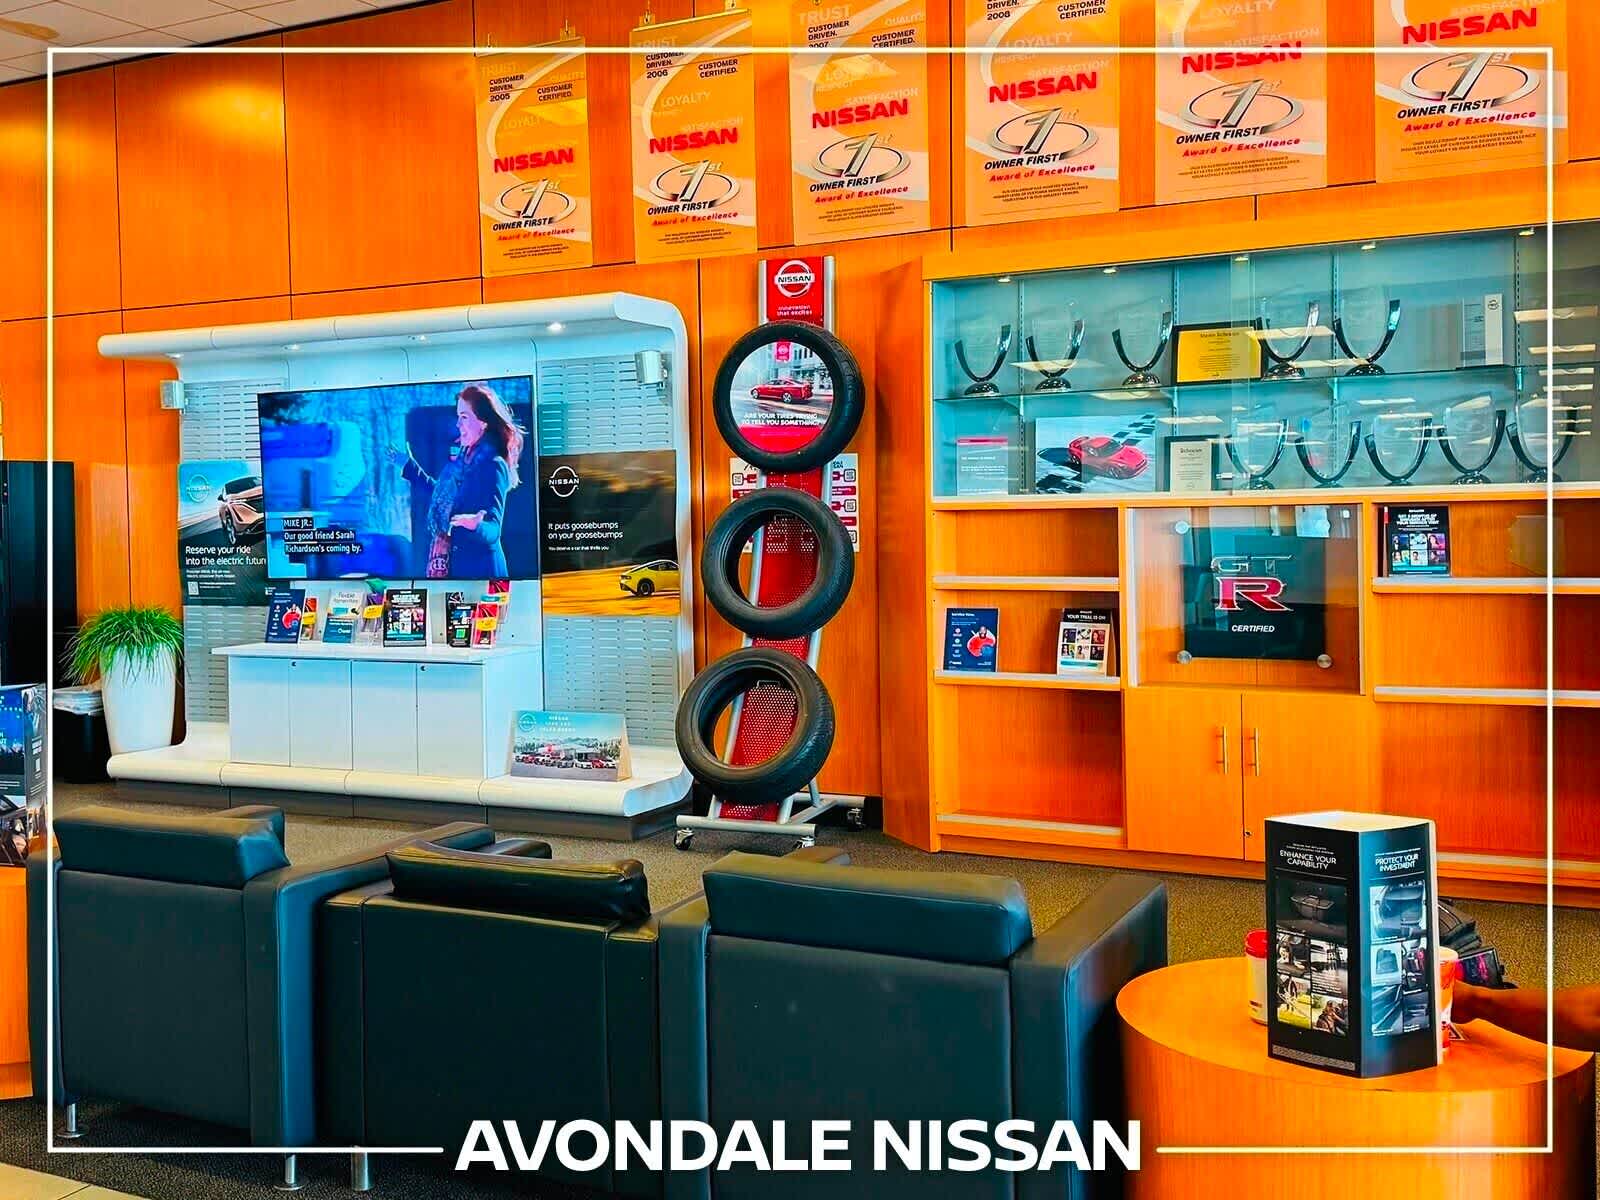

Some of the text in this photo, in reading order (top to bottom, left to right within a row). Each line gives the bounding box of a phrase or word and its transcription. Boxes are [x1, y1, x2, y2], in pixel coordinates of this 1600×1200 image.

[1057, 0, 1106, 12] CUSTOMER
[987, 11, 1011, 21] 2008
[1059, 7, 1106, 20] CERTIFIED.
[808, 20, 850, 33] CUSTOMER
[1402, 7, 1537, 45] NISSAN
[808, 30, 838, 41] DRIVEN.
[871, 29, 915, 42] CUSTOMER
[873, 37, 916, 48] CERTIFIED.
[1182, 41, 1302, 74] NISSAN
[698, 59, 738, 70] CUSTOMER
[647, 69, 669, 79] 2006
[700, 67, 738, 78] CERTIFIED.
[489, 74, 524, 85] CUSTOMER
[537, 83, 573, 94] CUSTOMER
[989, 72, 1097, 103] NISSAN
[489, 93, 511, 102] 2005
[812, 98, 908, 129] NISSAN
[1397, 99, 1489, 119] OWNER FIRST
[1404, 110, 1536, 132] Award of Excellence
[649, 127, 738, 154] NISSAN
[1176, 127, 1259, 145] OWNER FIRST
[1182, 137, 1300, 158] Award of Excellence
[494, 147, 574, 173] NISSAN
[984, 153, 1057, 171] OWNER FIRST
[989, 163, 1095, 182] Award of Excellence
[809, 176, 876, 192] OWNER FIRST
[815, 185, 909, 204] Award of Excellence
[648, 201, 709, 215] OWNER FIRST
[493, 218, 547, 231] OWNER FIRST
[652, 212, 738, 226] Award of Excellence
[533, 228, 575, 238] Excellence
[778, 275, 812, 283] NISSAN
[283, 519, 300, 527] MIKE
[554, 522, 570, 531] puts
[571, 522, 619, 531] goosebumps
[284, 531, 355, 541] Our good friend Sarah
[558, 532, 574, 540] your
[575, 531, 623, 540] goosebumps
[185, 545, 251, 556] Reserve your ride
[285, 544, 362, 554] Richardson's coming by.
[185, 556, 200, 565] into
[202, 556, 215, 565] the
[217, 556, 244, 565] electric
[1215, 576, 1294, 611] R
[1232, 625, 1275, 633] CERTIFIED
[1280, 850, 1337, 865] ENHANCE YOUR
[1287, 858, 1329, 870] CAPABILITY
[1375, 853, 1419, 866] PROTECT YOUR
[1380, 860, 1416, 872] INVESTMENT
